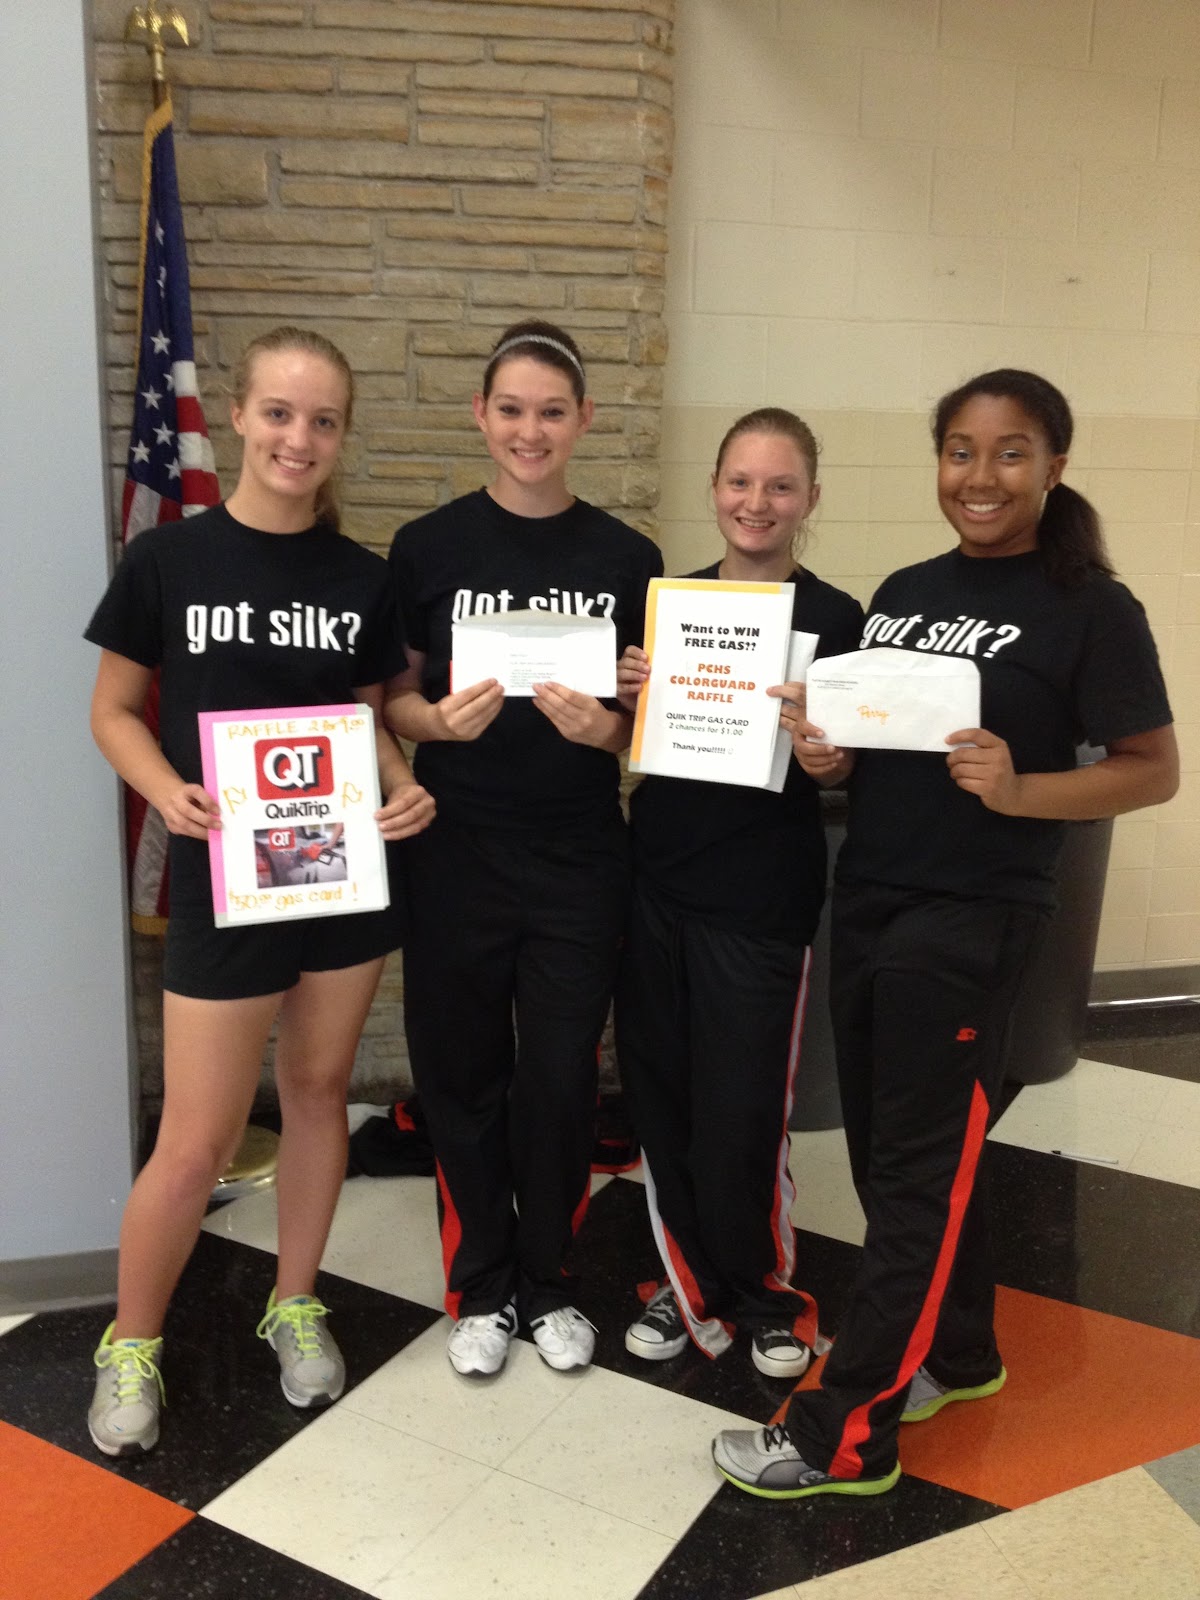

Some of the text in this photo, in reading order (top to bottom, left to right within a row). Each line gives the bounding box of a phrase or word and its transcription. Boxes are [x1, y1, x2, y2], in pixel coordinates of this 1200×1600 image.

[452, 588, 514, 624] got
[186, 601, 362, 655] got silk?
[680, 623, 760, 637] Want to WIN
[859, 613, 1022, 659] got silk?
[685, 638, 756, 651] FREE GAS??
[697, 663, 731, 675] PCHS
[670, 675, 756, 691] COLORGUARD
[687, 691, 734, 703] RAFFLE
[666, 712, 749, 727] QUIK TRIP GAS CARD
[675, 723, 705, 732] chances
[227, 721, 296, 739] RAFFLE
[672, 742, 696, 751] Thank
[263, 745, 323, 790] QT
[265, 801, 331, 819] QuikTrip
[271, 831, 292, 847] QT
[275, 893, 303, 911] gas
